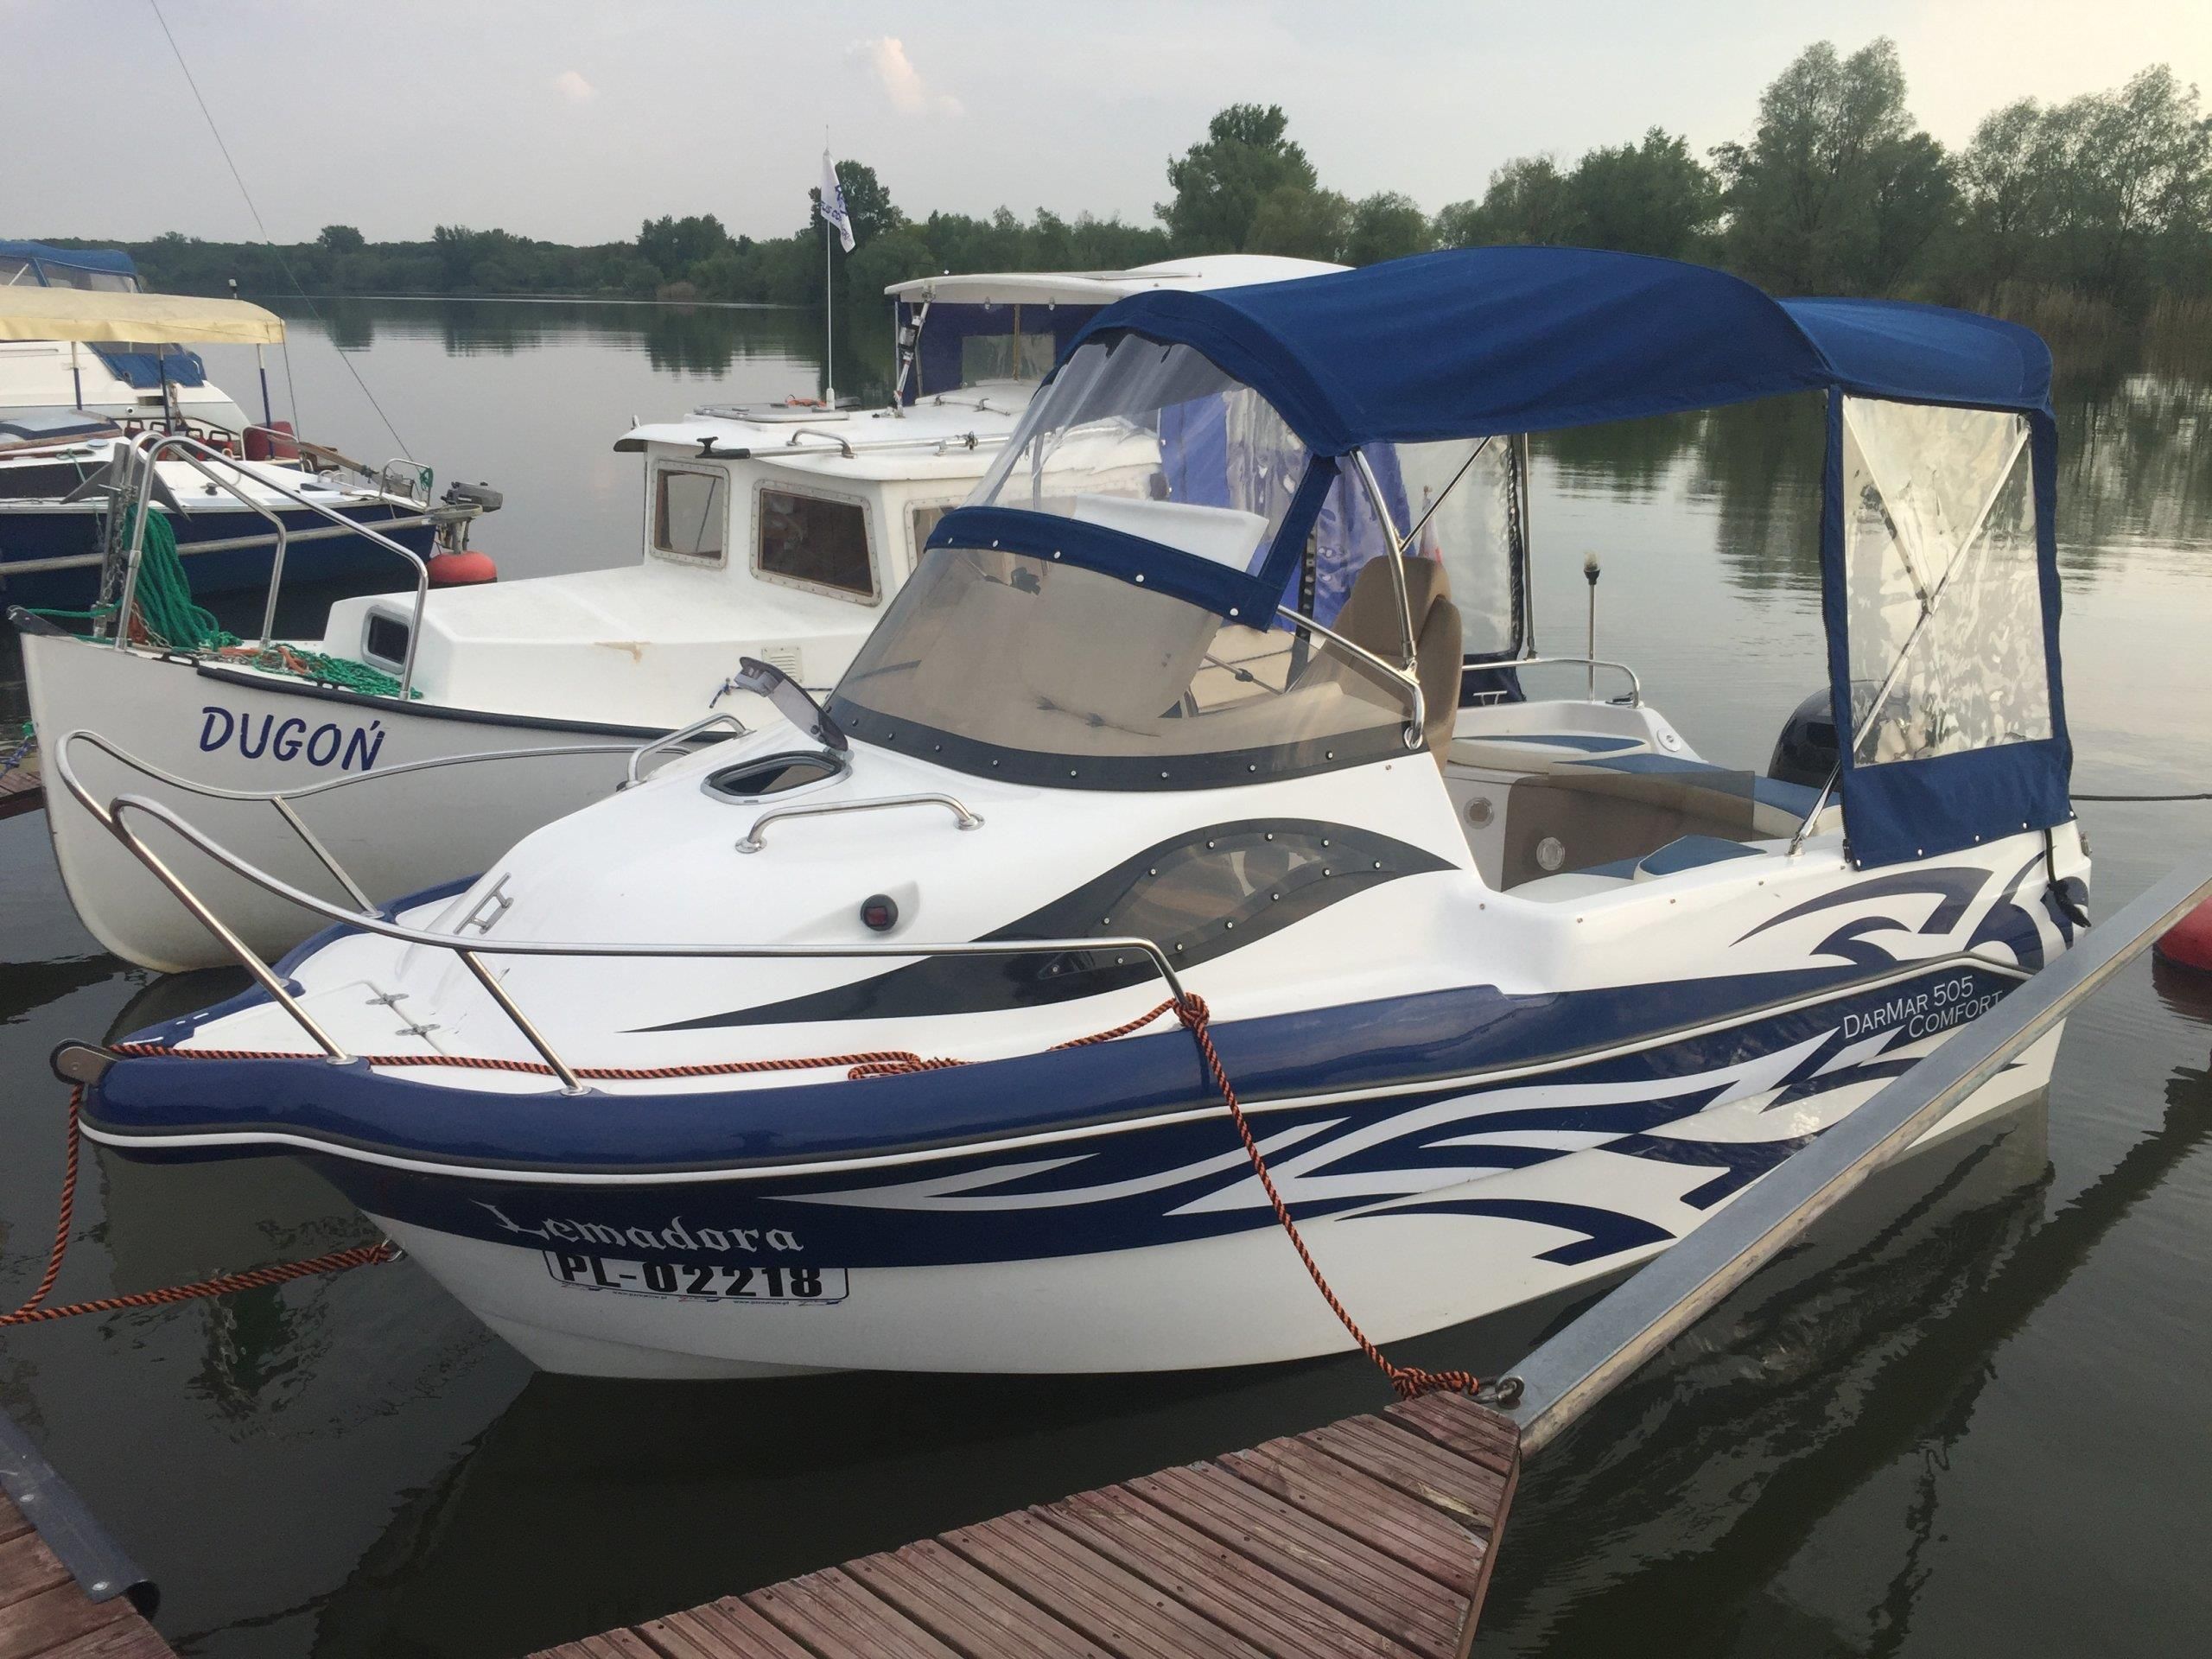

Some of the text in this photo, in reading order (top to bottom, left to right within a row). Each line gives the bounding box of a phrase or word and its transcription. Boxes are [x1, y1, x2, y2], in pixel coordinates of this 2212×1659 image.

[200, 706, 385, 772] DUGOŃ
[1933, 975, 1974, 1007] 505
[469, 1198, 804, 1253] Lemadora
[556, 1252, 823, 1297] PL-02218
